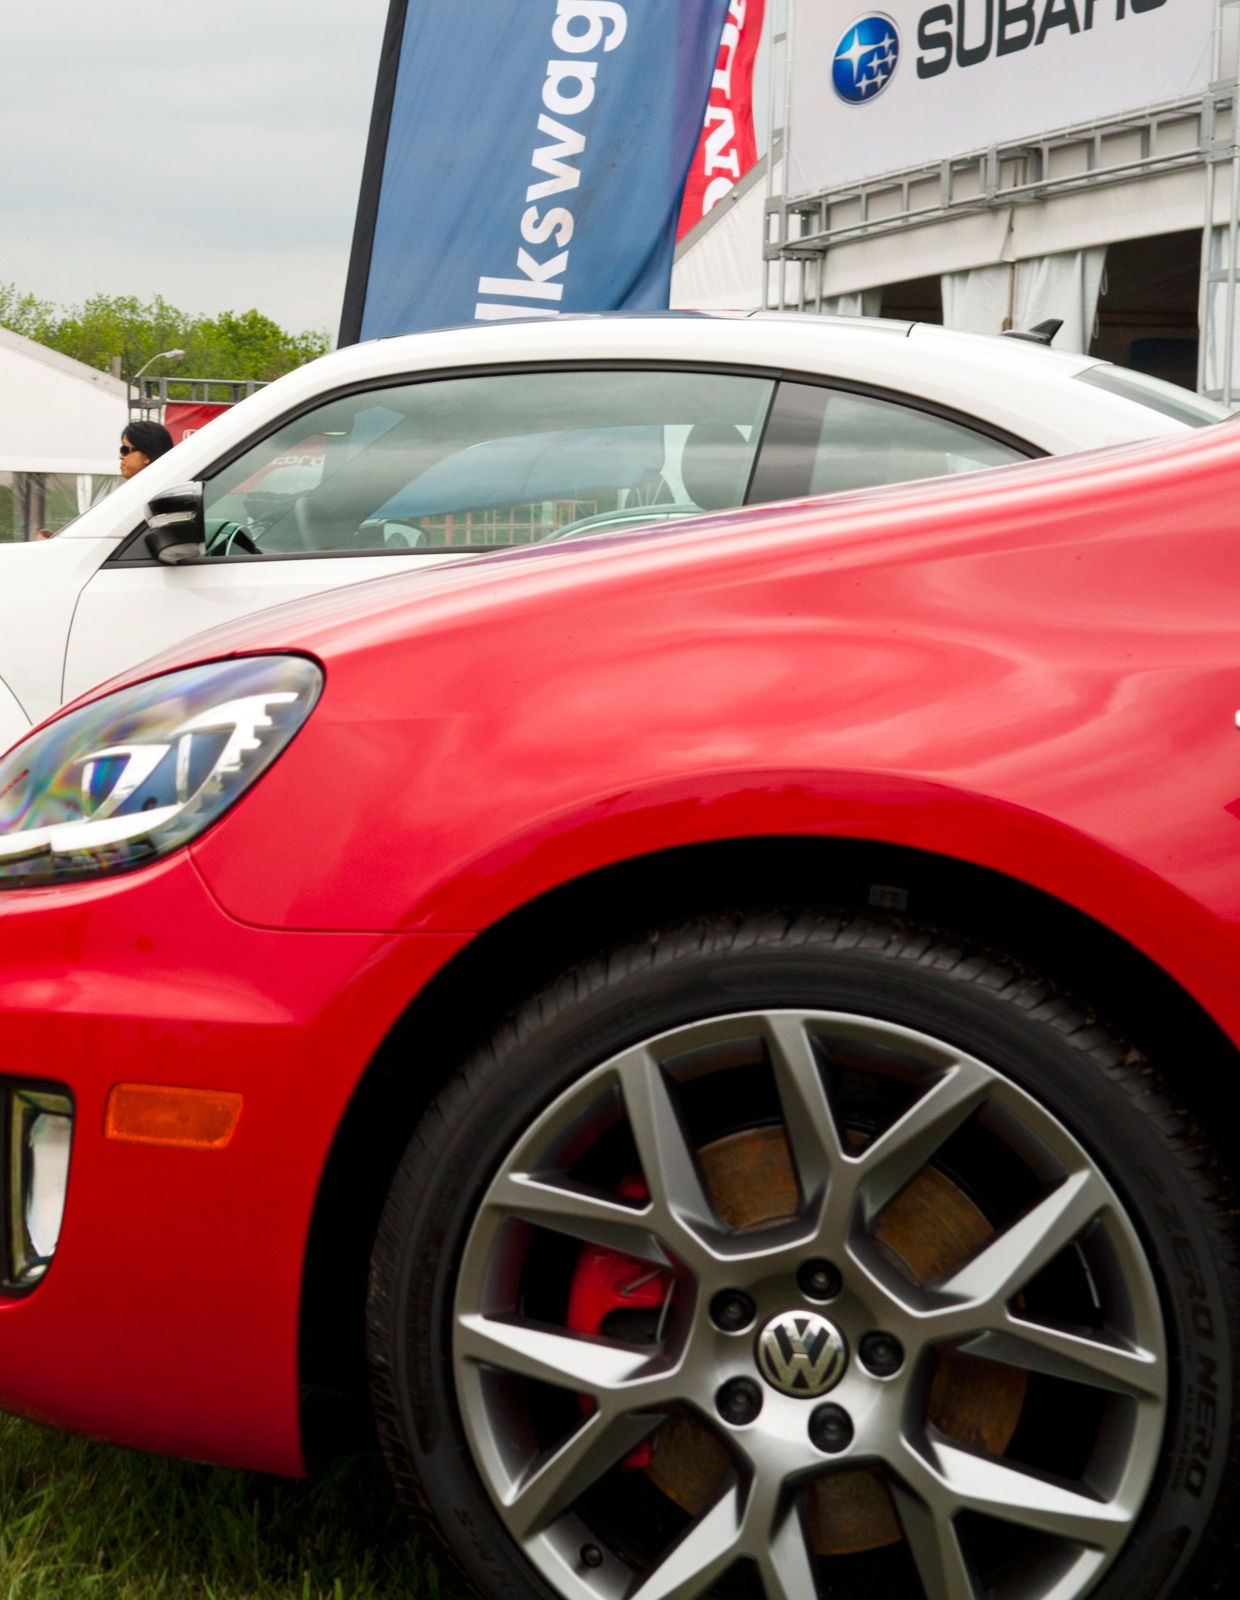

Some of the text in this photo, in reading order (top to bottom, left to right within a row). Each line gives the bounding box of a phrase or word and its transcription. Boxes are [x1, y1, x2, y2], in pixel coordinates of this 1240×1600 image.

[917, 0, 1168, 79] SUBA
[757, 1308, 847, 1398] VW
[1185, 1354, 1219, 1499] NERO
